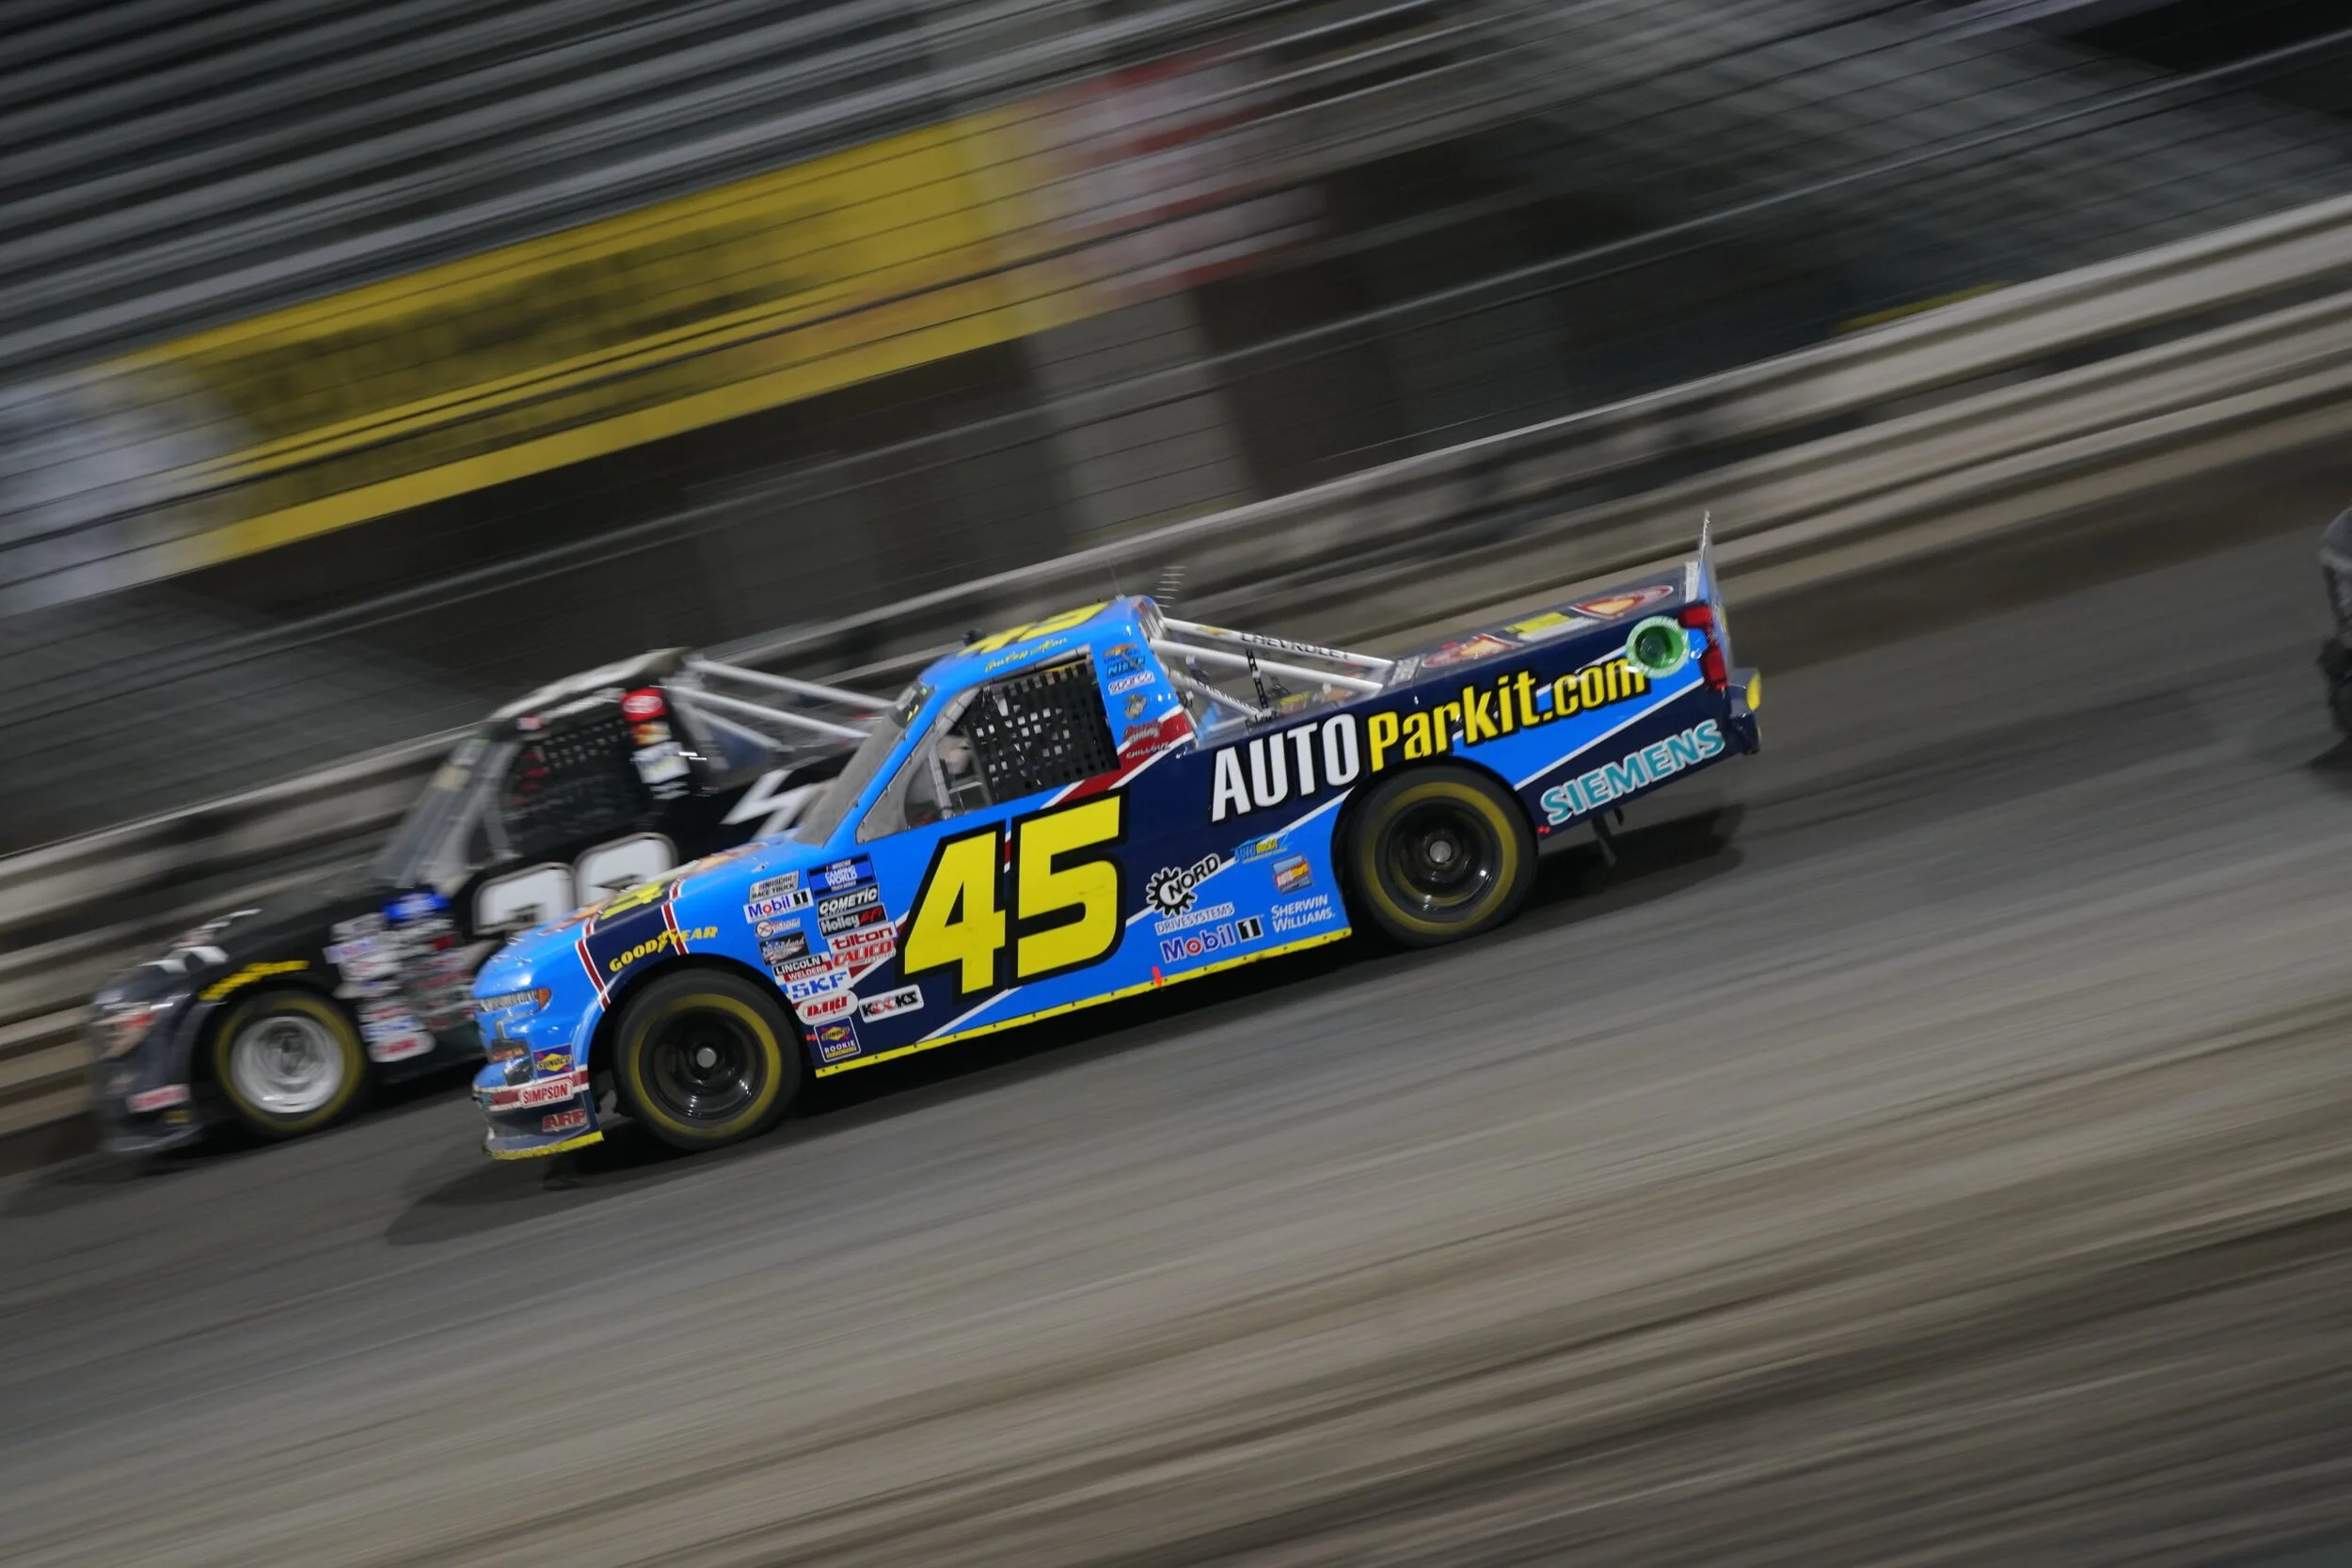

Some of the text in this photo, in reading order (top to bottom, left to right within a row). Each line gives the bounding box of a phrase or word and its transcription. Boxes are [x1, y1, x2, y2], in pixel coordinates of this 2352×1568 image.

[1540, 719, 1725, 826] SIEMENS
[772, 883, 794, 895] TRUCK
[827, 872, 857, 887] WORLD
[1168, 855, 1220, 900] NORD
[818, 887, 878, 915] COMETIC
[904, 795, 1120, 994] 45
[748, 895, 790, 919] Mobil
[1155, 902, 1234, 936] DRIVESYSTEMS
[1271, 895, 1328, 920] SHERWIN
[820, 914, 860, 934] Holley
[1272, 909, 1333, 933] WILLIAMS
[609, 926, 719, 973] GOODYEAR
[832, 927, 893, 950] tilton
[1160, 925, 1235, 963] Mobil
[834, 941, 893, 966] CALICO
[775, 956, 822, 976] LINCOLN
[787, 965, 828, 981] WELDERS
[791, 972, 847, 1000] SKF
[824, 1039, 856, 1054] ROOKIE
[535, 1053, 573, 1070] SUNOCO
[522, 1084, 568, 1105] SIMPSON
[543, 1110, 586, 1131] ARP
